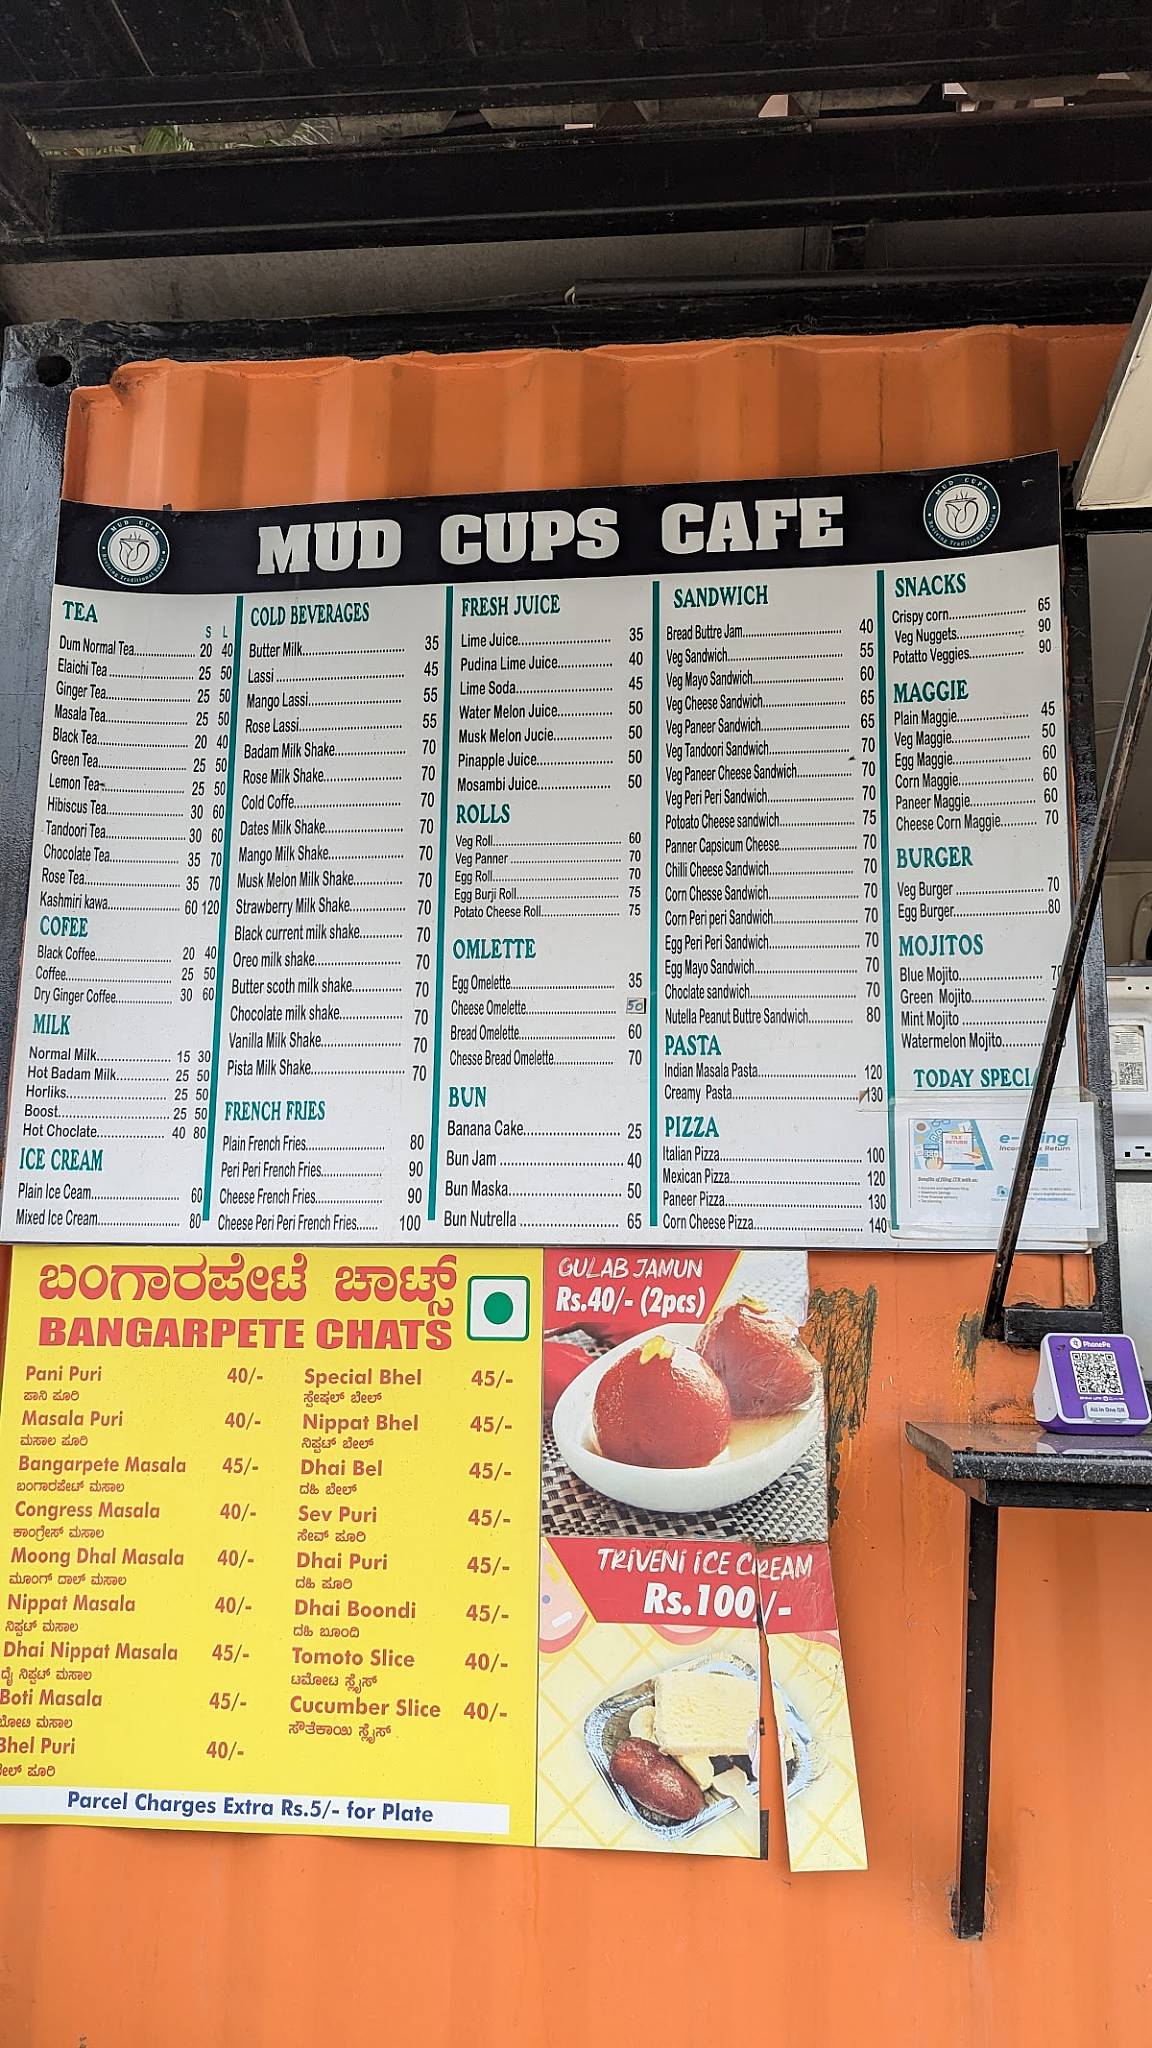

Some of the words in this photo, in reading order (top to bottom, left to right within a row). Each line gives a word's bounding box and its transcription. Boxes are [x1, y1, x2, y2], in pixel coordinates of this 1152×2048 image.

[257, 519, 401, 574] MUD
[440, 508, 619, 565] CUPS
[661, 496, 844, 555] CAFE
[895, 572, 966, 598] SNACKS
[462, 596, 509, 617] FRESH
[514, 594, 560, 614] JUICE
[674, 585, 768, 609] SANDWICH
[63, 601, 98, 623] TEA
[250, 606, 286, 627] COLD
[291, 602, 369, 624] BEVERAGES
[892, 609, 923, 624] Crispy
[1038, 597, 1050, 612] 65
[205, 626, 211, 638] S
[223, 626, 228, 638] L
[60, 636, 80, 651] Dum
[82, 637, 116, 654] Normal
[200, 643, 212, 657] 20
[221, 643, 233, 657] 40
[58, 658, 89, 675] Elaichi
[91, 663, 107, 676] Tea
[199, 666, 211, 681] 25
[220, 666, 232, 680] 50
[248, 668, 274, 684] Lassi
[424, 662, 438, 676] 45
[893, 680, 969, 704] MAGGIE
[666, 766, 683, 782] Veg
[685, 765, 716, 782] Paneer
[718, 764, 752, 780] Cheese
[862, 762, 875, 777] 70
[456, 804, 510, 825] ROLLS
[455, 852, 473, 866] Veg
[475, 851, 508, 865] Panner
[629, 849, 642, 862] 70
[896, 847, 973, 869] BURGER
[237, 872, 264, 888] Musk
[266, 872, 297, 888] Melon
[300, 871, 318, 887] Milk
[418, 872, 432, 888] 70
[897, 882, 917, 898] Veg
[919, 880, 953, 898] Burger
[1047, 876, 1060, 892] 70
[40, 916, 88, 938] COFEE
[453, 939, 536, 959] OMLETTE
[899, 934, 983, 956] MOJITOS
[451, 1000, 484, 1016] Cheese
[665, 1008, 697, 1024] Nutella
[699, 1008, 731, 1024] Peanut
[733, 1008, 762, 1024] Buttre
[866, 1007, 881, 1023] 80
[33, 1015, 70, 1036] MILK
[901, 1011, 923, 1026] Mint
[927, 1011, 959, 1029] Mojito
[664, 1035, 721, 1056] PASTA
[27, 1065, 46, 1079] Hot
[48, 1066, 92, 1080] Badam
[175, 1069, 189, 1082] 25
[196, 1069, 209, 1082] 50
[913, 1069, 974, 1088] TODAY
[448, 1087, 487, 1107] BUN
[224, 1101, 281, 1121] FRENCH
[286, 1101, 325, 1120] FRIES
[664, 1117, 719, 1137] PIZZA
[19, 1149, 45, 1170] ICE
[50, 1150, 103, 1171] CREAM
[446, 1151, 469, 1167] Bun
[471, 1151, 497, 1167] Jam
[627, 1153, 642, 1169] 40
[218, 1215, 252, 1230] Cheese
[254, 1215, 275, 1231] Peri
[277, 1215, 298, 1231] Peri
[300, 1215, 333, 1230] French
[400, 1216, 420, 1232] 100
[444, 1211, 466, 1228] Bun
[469, 1211, 517, 1227] Nutrella
[627, 1214, 642, 1229] 65
[559, 1257, 629, 1279] GULAB
[633, 1258, 702, 1279] JAMUN
[556, 1286, 633, 1315] Rs.40/-
[641, 1286, 704, 1319] (2pcs)
[39, 1317, 304, 1348] BANGARPETE
[316, 1319, 452, 1350] CHATS
[26, 1366, 63, 1381] Pani
[69, 1366, 102, 1381] Puri
[227, 1367, 263, 1385] 40/-
[304, 1368, 372, 1388] Special
[380, 1369, 422, 1385] Bhel
[471, 1370, 513, 1388] 45/-
[303, 1414, 369, 1434] Nippat
[376, 1414, 418, 1431] Bhel
[470, 1416, 512, 1435] 45/-
[19, 1456, 119, 1475] Bangarpete
[125, 1456, 186, 1472] Masala
[222, 1457, 259, 1475] 45/-
[301, 1459, 345, 1475] Dhai
[353, 1460, 382, 1476] Bel
[469, 1462, 512, 1481] 45/-
[298, 1506, 332, 1522] Sev
[339, 1507, 377, 1523] Puri
[468, 1509, 510, 1528] 45/-
[11, 1547, 70, 1568] Moong
[77, 1548, 116, 1564] Dhal
[122, 1549, 184, 1565] Masala
[218, 1550, 254, 1568] 40/-
[736, 1552, 813, 1581] CREAM
[294, 1599, 340, 1616] Dhai
[348, 1601, 416, 1618] Boondi
[466, 1604, 509, 1624] 45/-
[0, 1688, 33, 1706] Boti
[39, 1690, 102, 1707] Masala
[209, 1692, 247, 1712] 45/-
[290, 1696, 390, 1716] Cucumber
[396, 1699, 440, 1718] Slice
[464, 1702, 507, 1722] 40/-
[68, 1791, 128, 1810] Parcel
[135, 1794, 216, 1817] Charges
[224, 1796, 274, 1816] Extra
[282, 1799, 340, 1820] Rs.5/-
[346, 1801, 375, 1820] for
[382, 1803, 433, 1822] Plate
